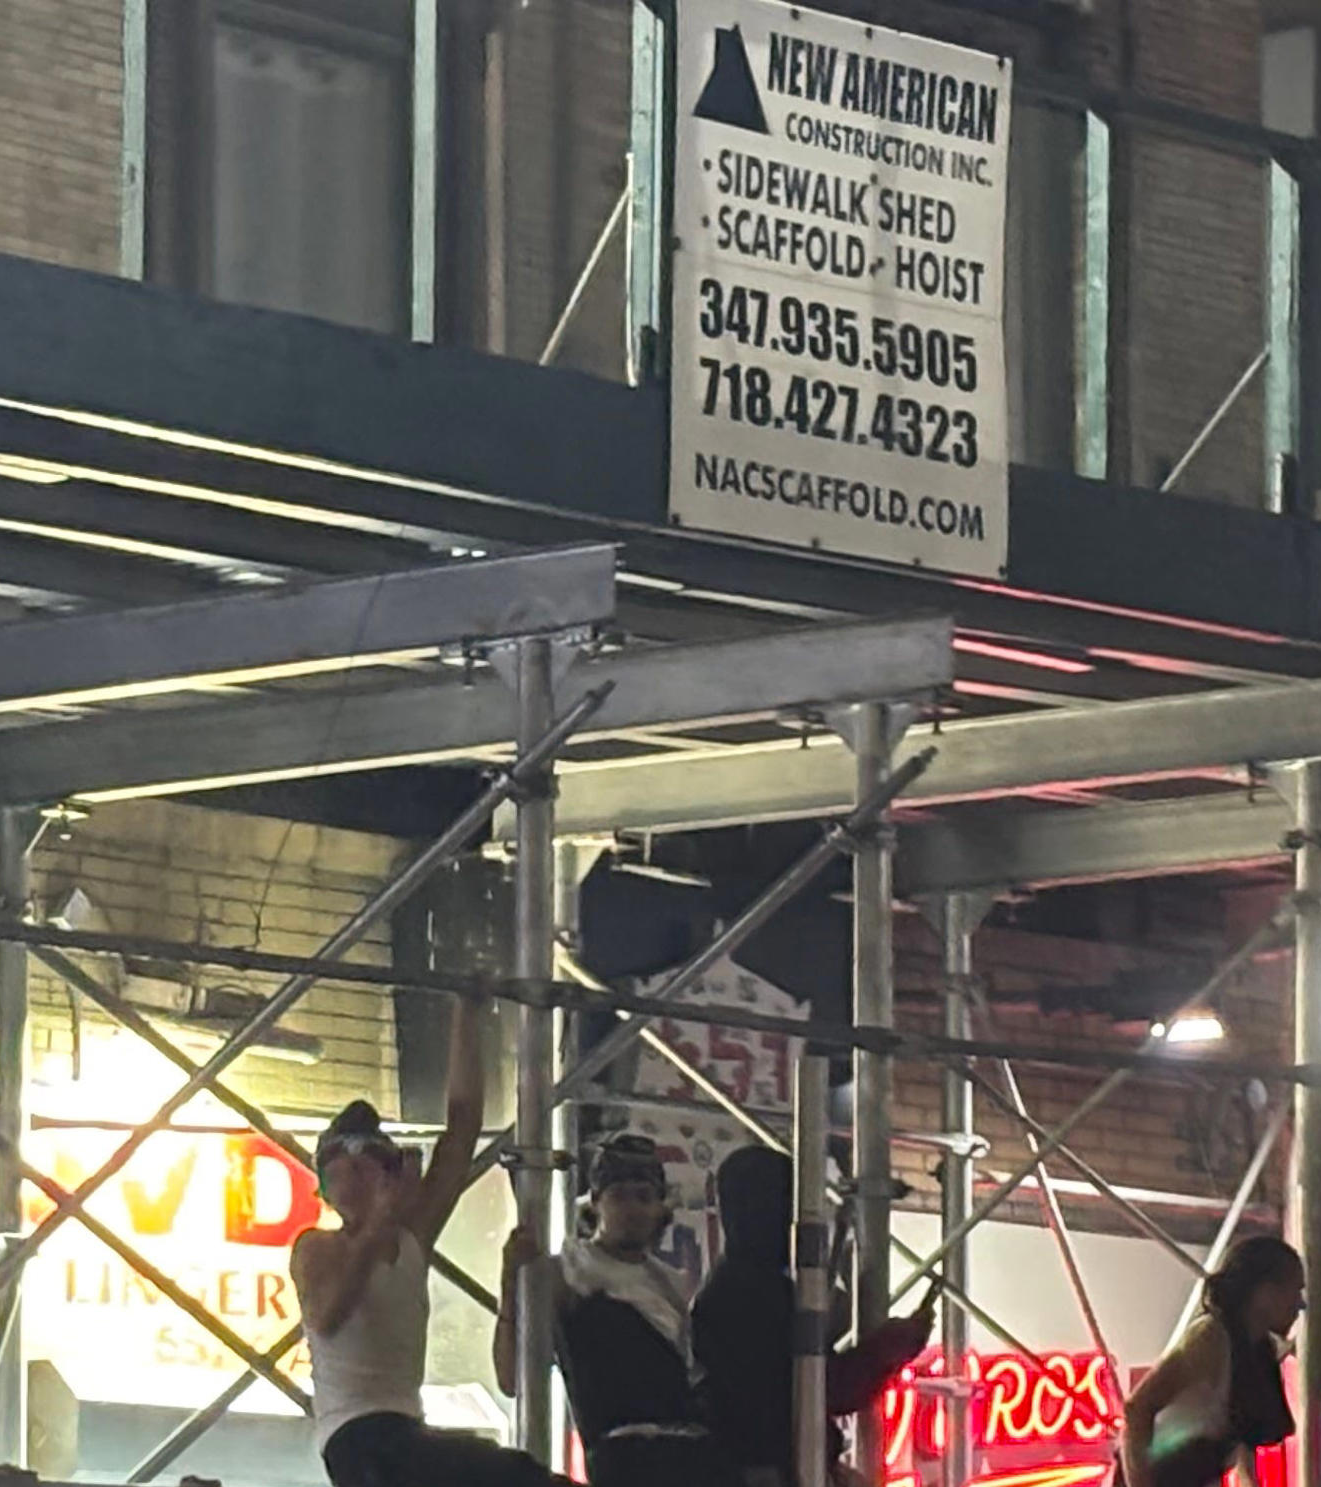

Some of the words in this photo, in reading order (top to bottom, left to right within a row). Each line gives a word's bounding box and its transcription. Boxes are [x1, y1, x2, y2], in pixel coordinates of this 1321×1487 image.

[768, 31, 838, 105] NEW
[840, 52, 998, 145] AMERICAN
[717, 148, 870, 227] SIDEWALK
[878, 187, 957, 245] SHED
[785, 112, 945, 176] CONSTRUCTION
[951, 151, 993, 188] INC.
[717, 204, 866, 278] SCAFFOLD
[895, 245, 985, 305] HOIST
[699, 278, 978, 393] 347.935.5905
[699, 356, 978, 469] 718.427.4323
[694, 451, 986, 541] NACSCAFFOLD.COM
